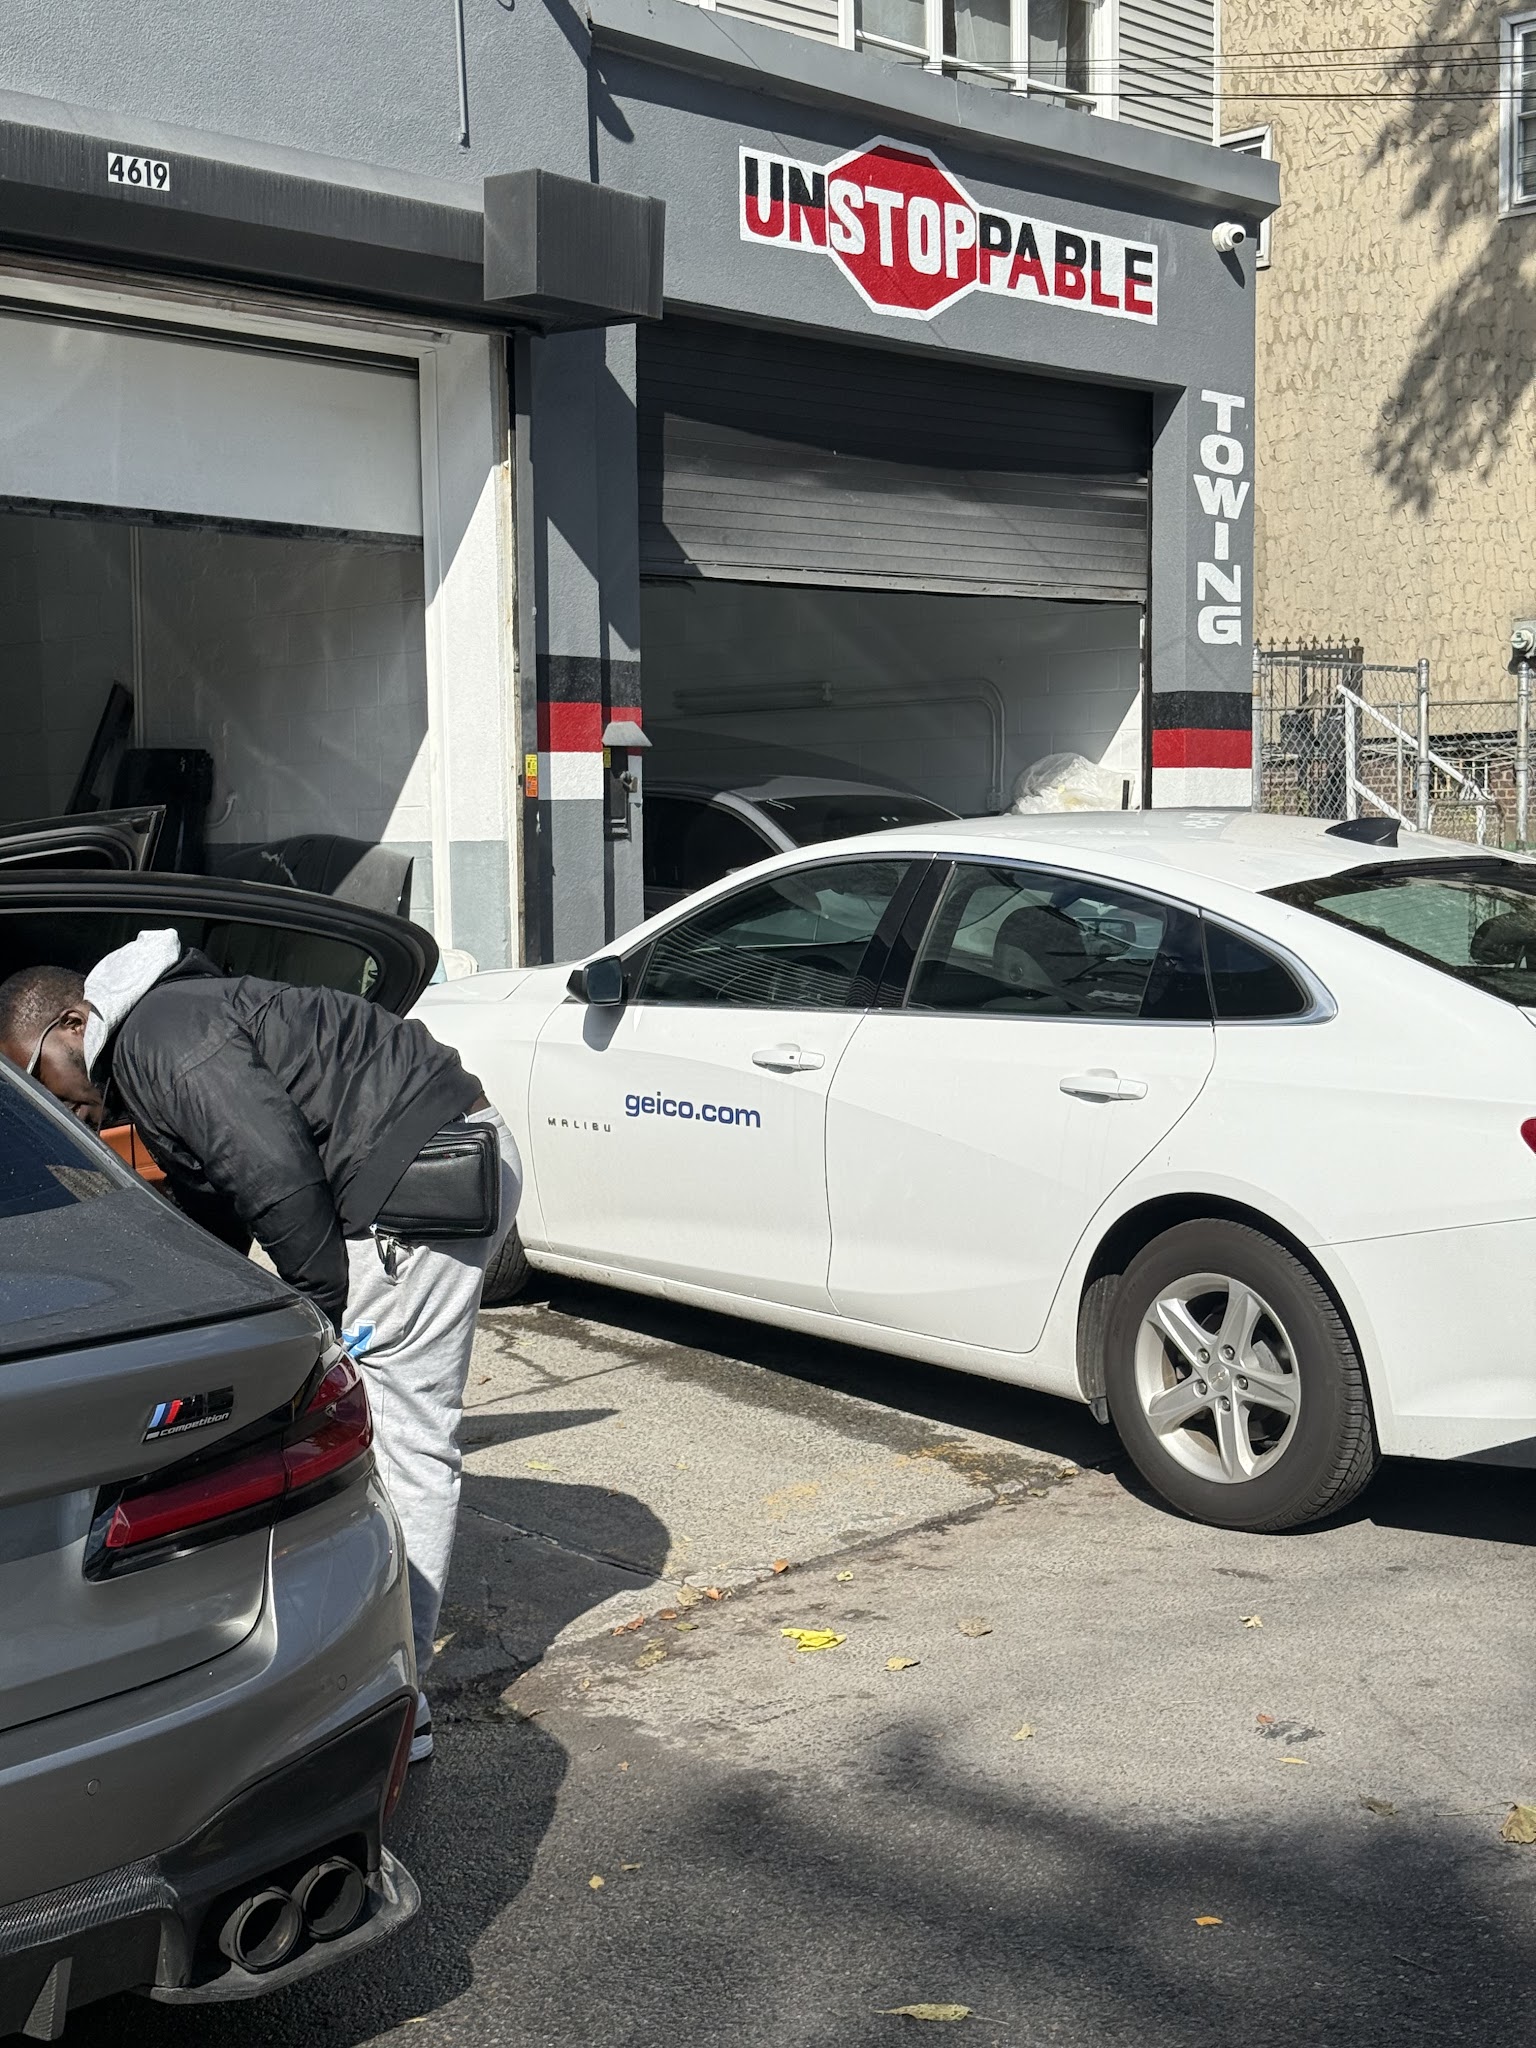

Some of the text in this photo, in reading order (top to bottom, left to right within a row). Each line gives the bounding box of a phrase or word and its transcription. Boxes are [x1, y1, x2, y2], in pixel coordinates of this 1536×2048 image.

[109, 155, 168, 188] 4619
[744, 156, 1154, 316] UNSTOPPABLE
[1192, 388, 1251, 647] TOWING
[547, 1116, 612, 1133] MALIBU
[625, 1091, 761, 1129] geico.com
[160, 1411, 230, 1437] competition
